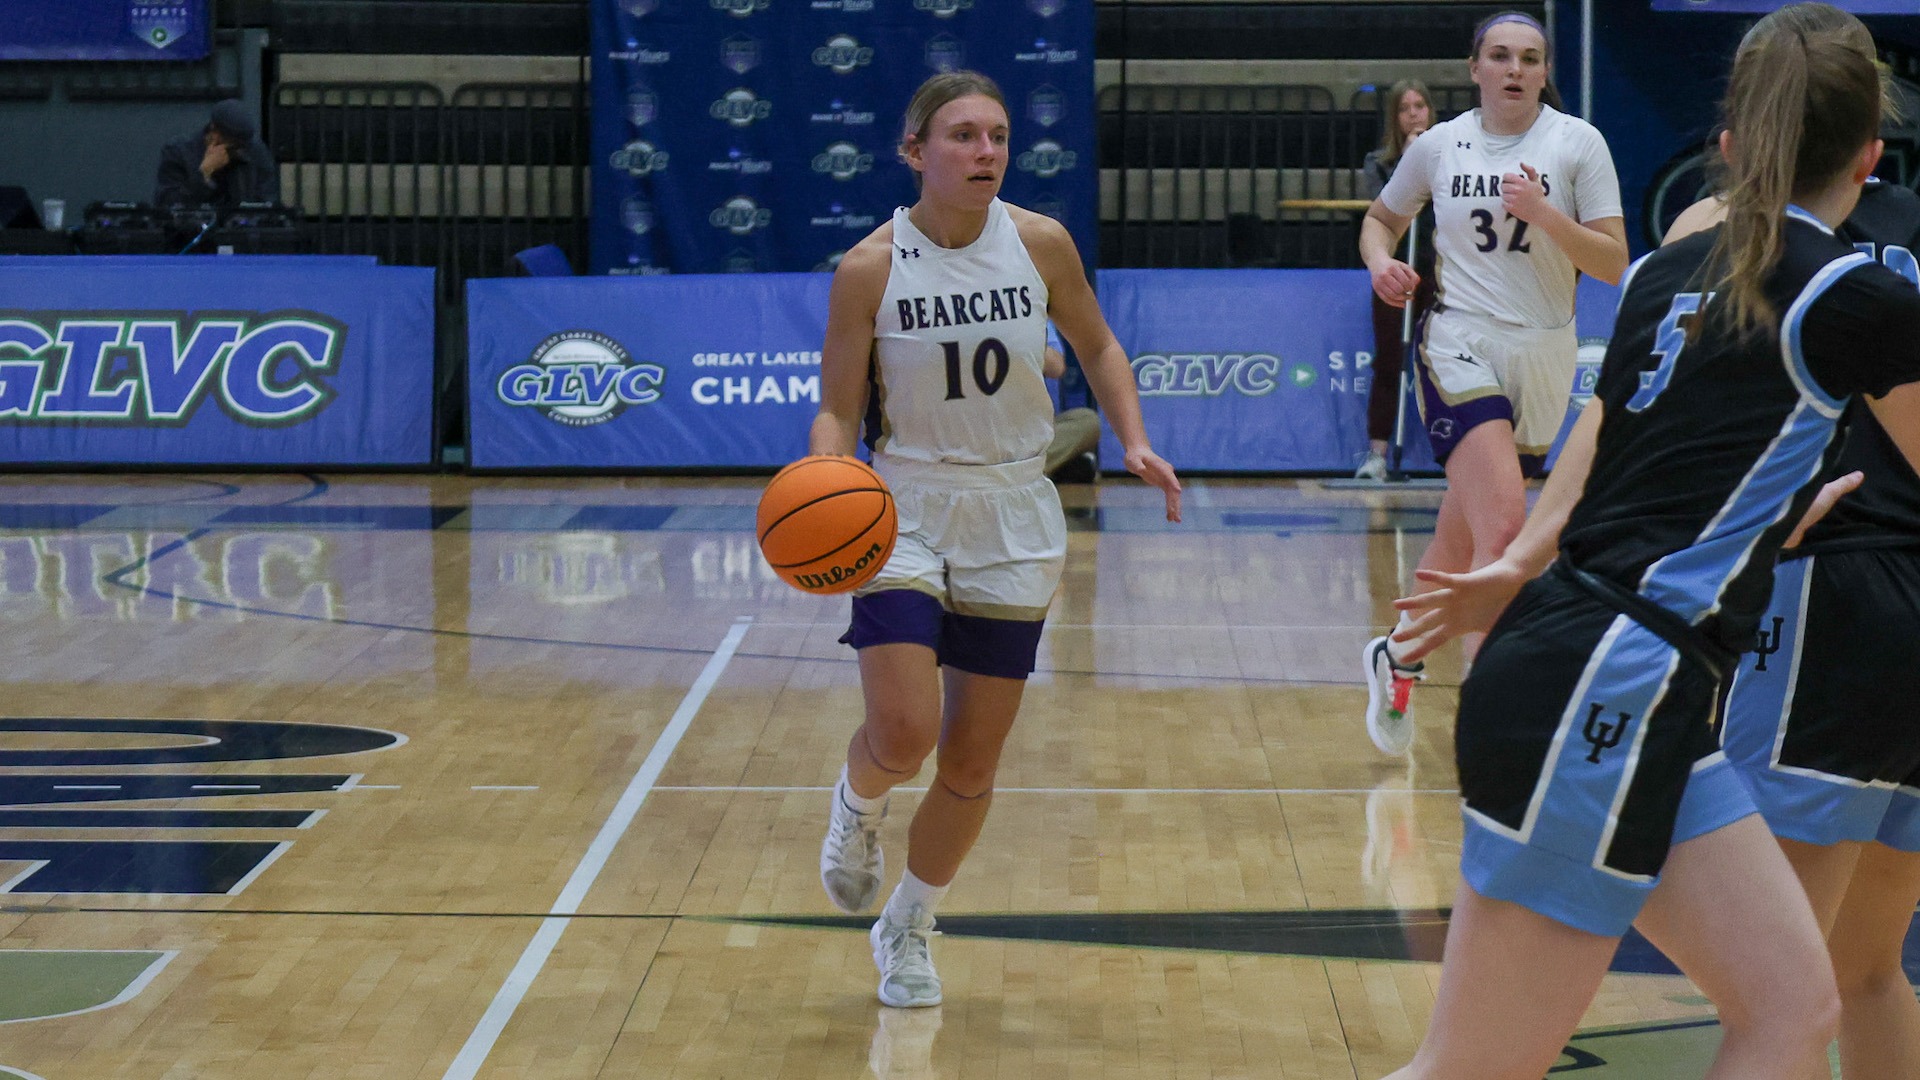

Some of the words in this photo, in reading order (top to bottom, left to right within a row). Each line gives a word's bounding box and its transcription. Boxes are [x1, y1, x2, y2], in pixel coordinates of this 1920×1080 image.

[1451, 173, 1550, 198] BEARS
[1470, 208, 1531, 254] 32
[897, 285, 1032, 332] BEARCATS
[692, 352, 756, 367] GREAT
[761, 351, 822, 366] LAKES
[937, 337, 1010, 401] 10
[1625, 292, 1717, 414] 5
[497, 363, 665, 406] GLVC
[691, 375, 822, 405] CHAM
[1131, 354, 1280, 397] GLVC
[793, 542, 883, 589] Wilson
